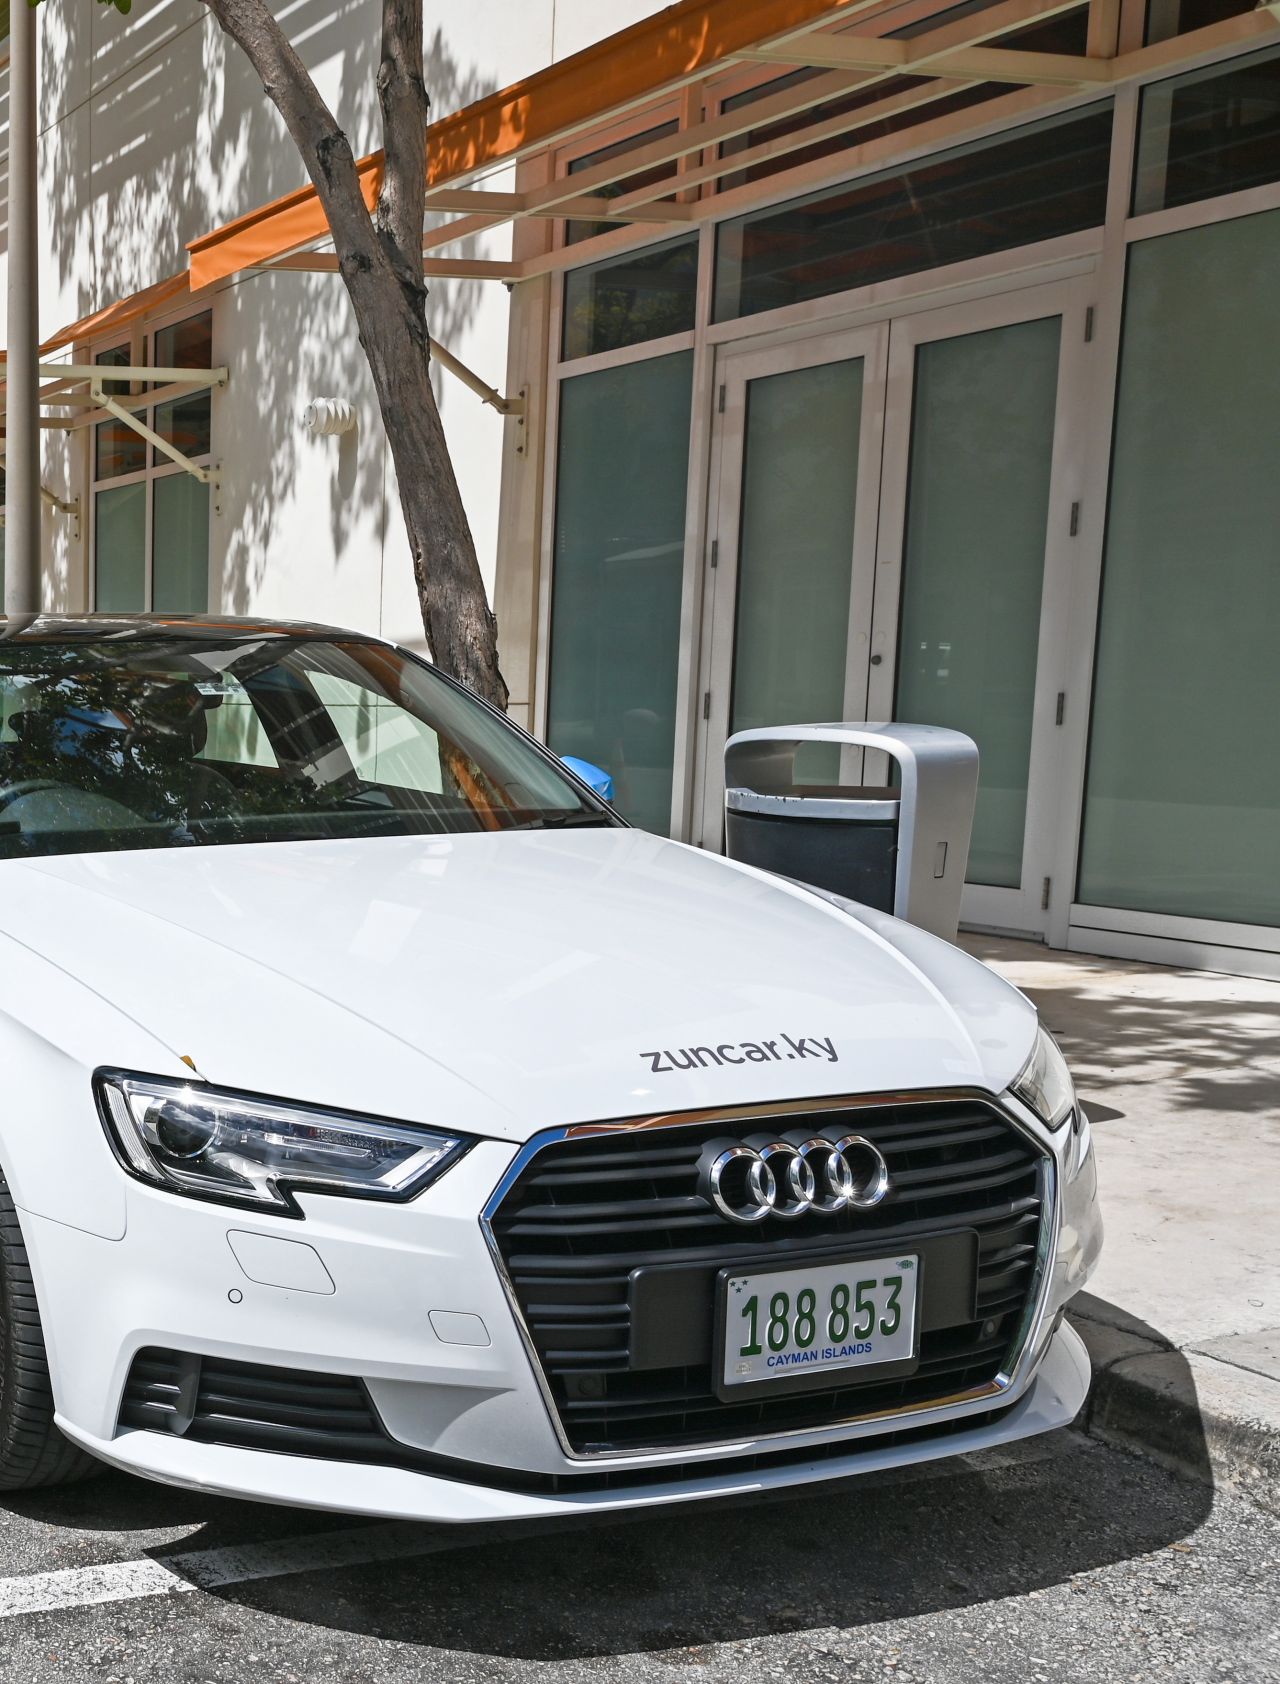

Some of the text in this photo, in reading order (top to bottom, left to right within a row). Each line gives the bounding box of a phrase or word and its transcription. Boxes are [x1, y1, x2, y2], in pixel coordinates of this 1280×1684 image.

[639, 1033, 838, 1072] zuncar.ky
[739, 1275, 903, 1356] 188 853
[766, 1350, 818, 1368] CAYMAN
[821, 1342, 872, 1360] ISLANDS
